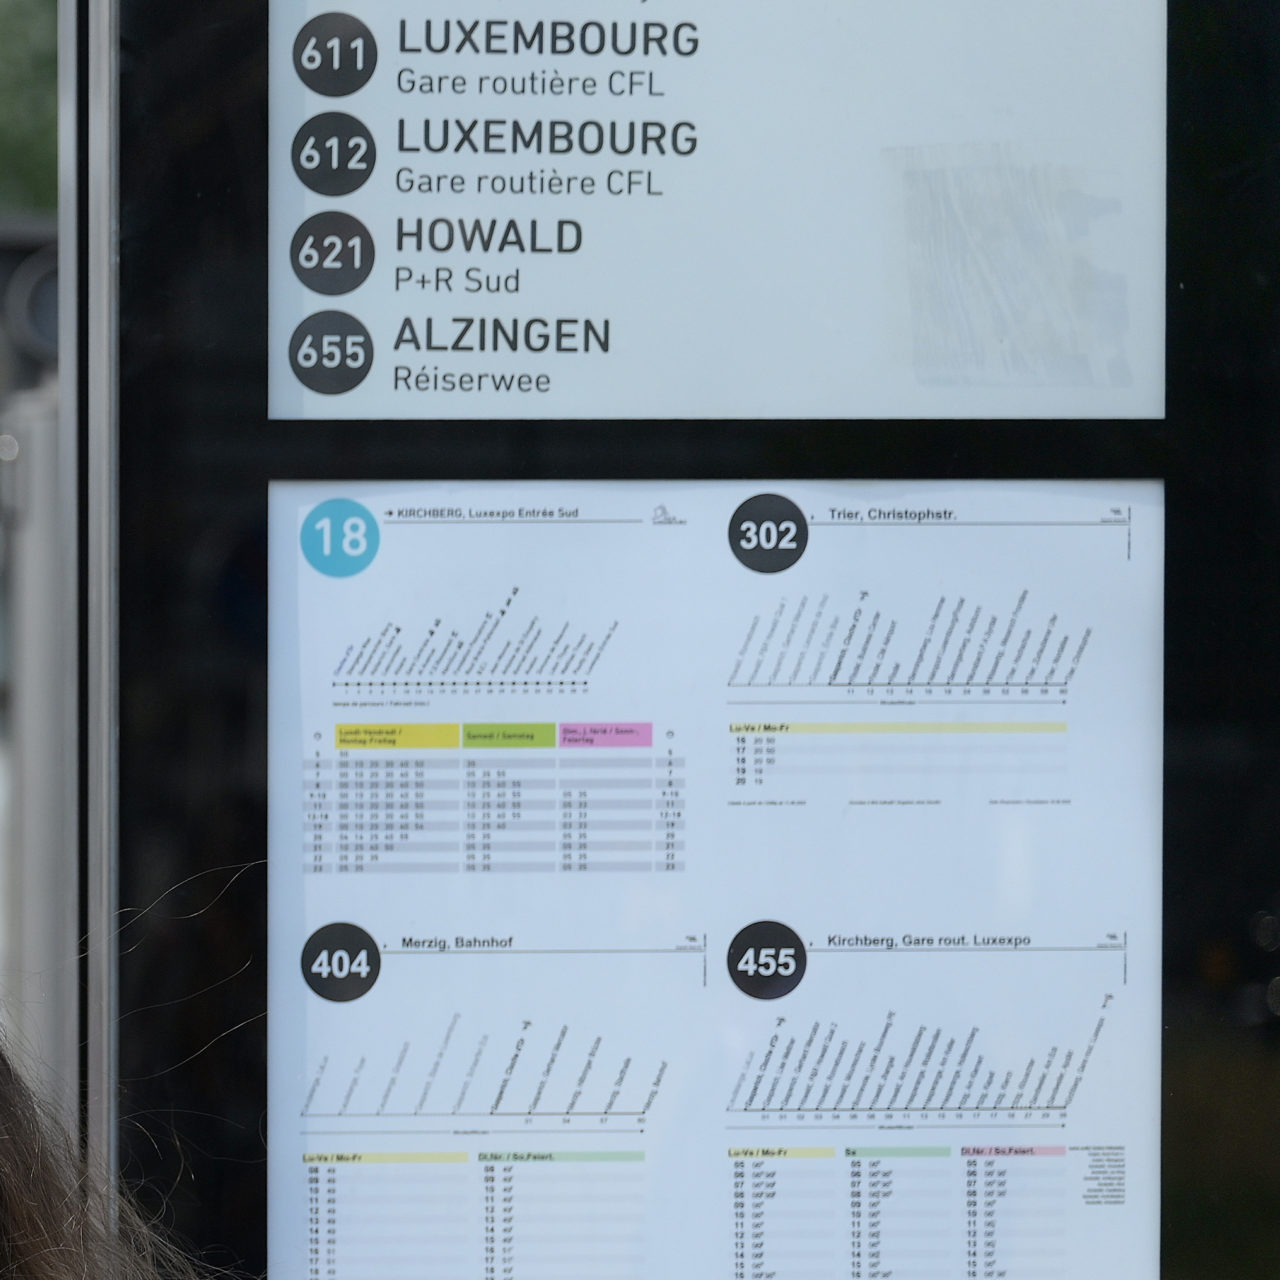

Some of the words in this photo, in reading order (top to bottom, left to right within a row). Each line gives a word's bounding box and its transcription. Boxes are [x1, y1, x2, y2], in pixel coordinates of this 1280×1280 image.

[300, 36, 366, 71] 611
[398, 18, 700, 58] LUXEMBOURG
[396, 68, 467, 96] Gare
[478, 69, 597, 97] routière
[608, 70, 665, 98] CFL
[298, 136, 369, 170] 612
[397, 118, 699, 157] LUXEMBOURG
[395, 167, 465, 195] Gare
[477, 168, 596, 196] routière
[606, 169, 663, 197] CFL
[297, 235, 365, 269] 621
[396, 217, 583, 254] HOWALD
[395, 266, 453, 293] P+R
[464, 267, 521, 294] Sud
[296, 335, 366, 369] 655
[393, 316, 610, 354] ALZINGEN
[393, 364, 551, 393] Réiserwee
[314, 515, 369, 557] 18
[397, 507, 467, 521] KIRCHBERG,
[468, 507, 516, 520] Luxexpo
[518, 506, 555, 519] Entrée
[557, 507, 580, 519] Sud
[738, 520, 798, 550] 302
[829, 508, 864, 522] Trier,
[867, 508, 957, 523] Christophstr.
[310, 949, 371, 979] 404
[401, 937, 451, 951] Merzig,
[454, 936, 514, 949] Bahnhof
[737, 947, 797, 977] 455
[827, 935, 898, 949] Kirchberg,
[901, 935, 935, 947] Gare
[938, 935, 969, 947] rout.
[972, 935, 1031, 949] Luxexpo
